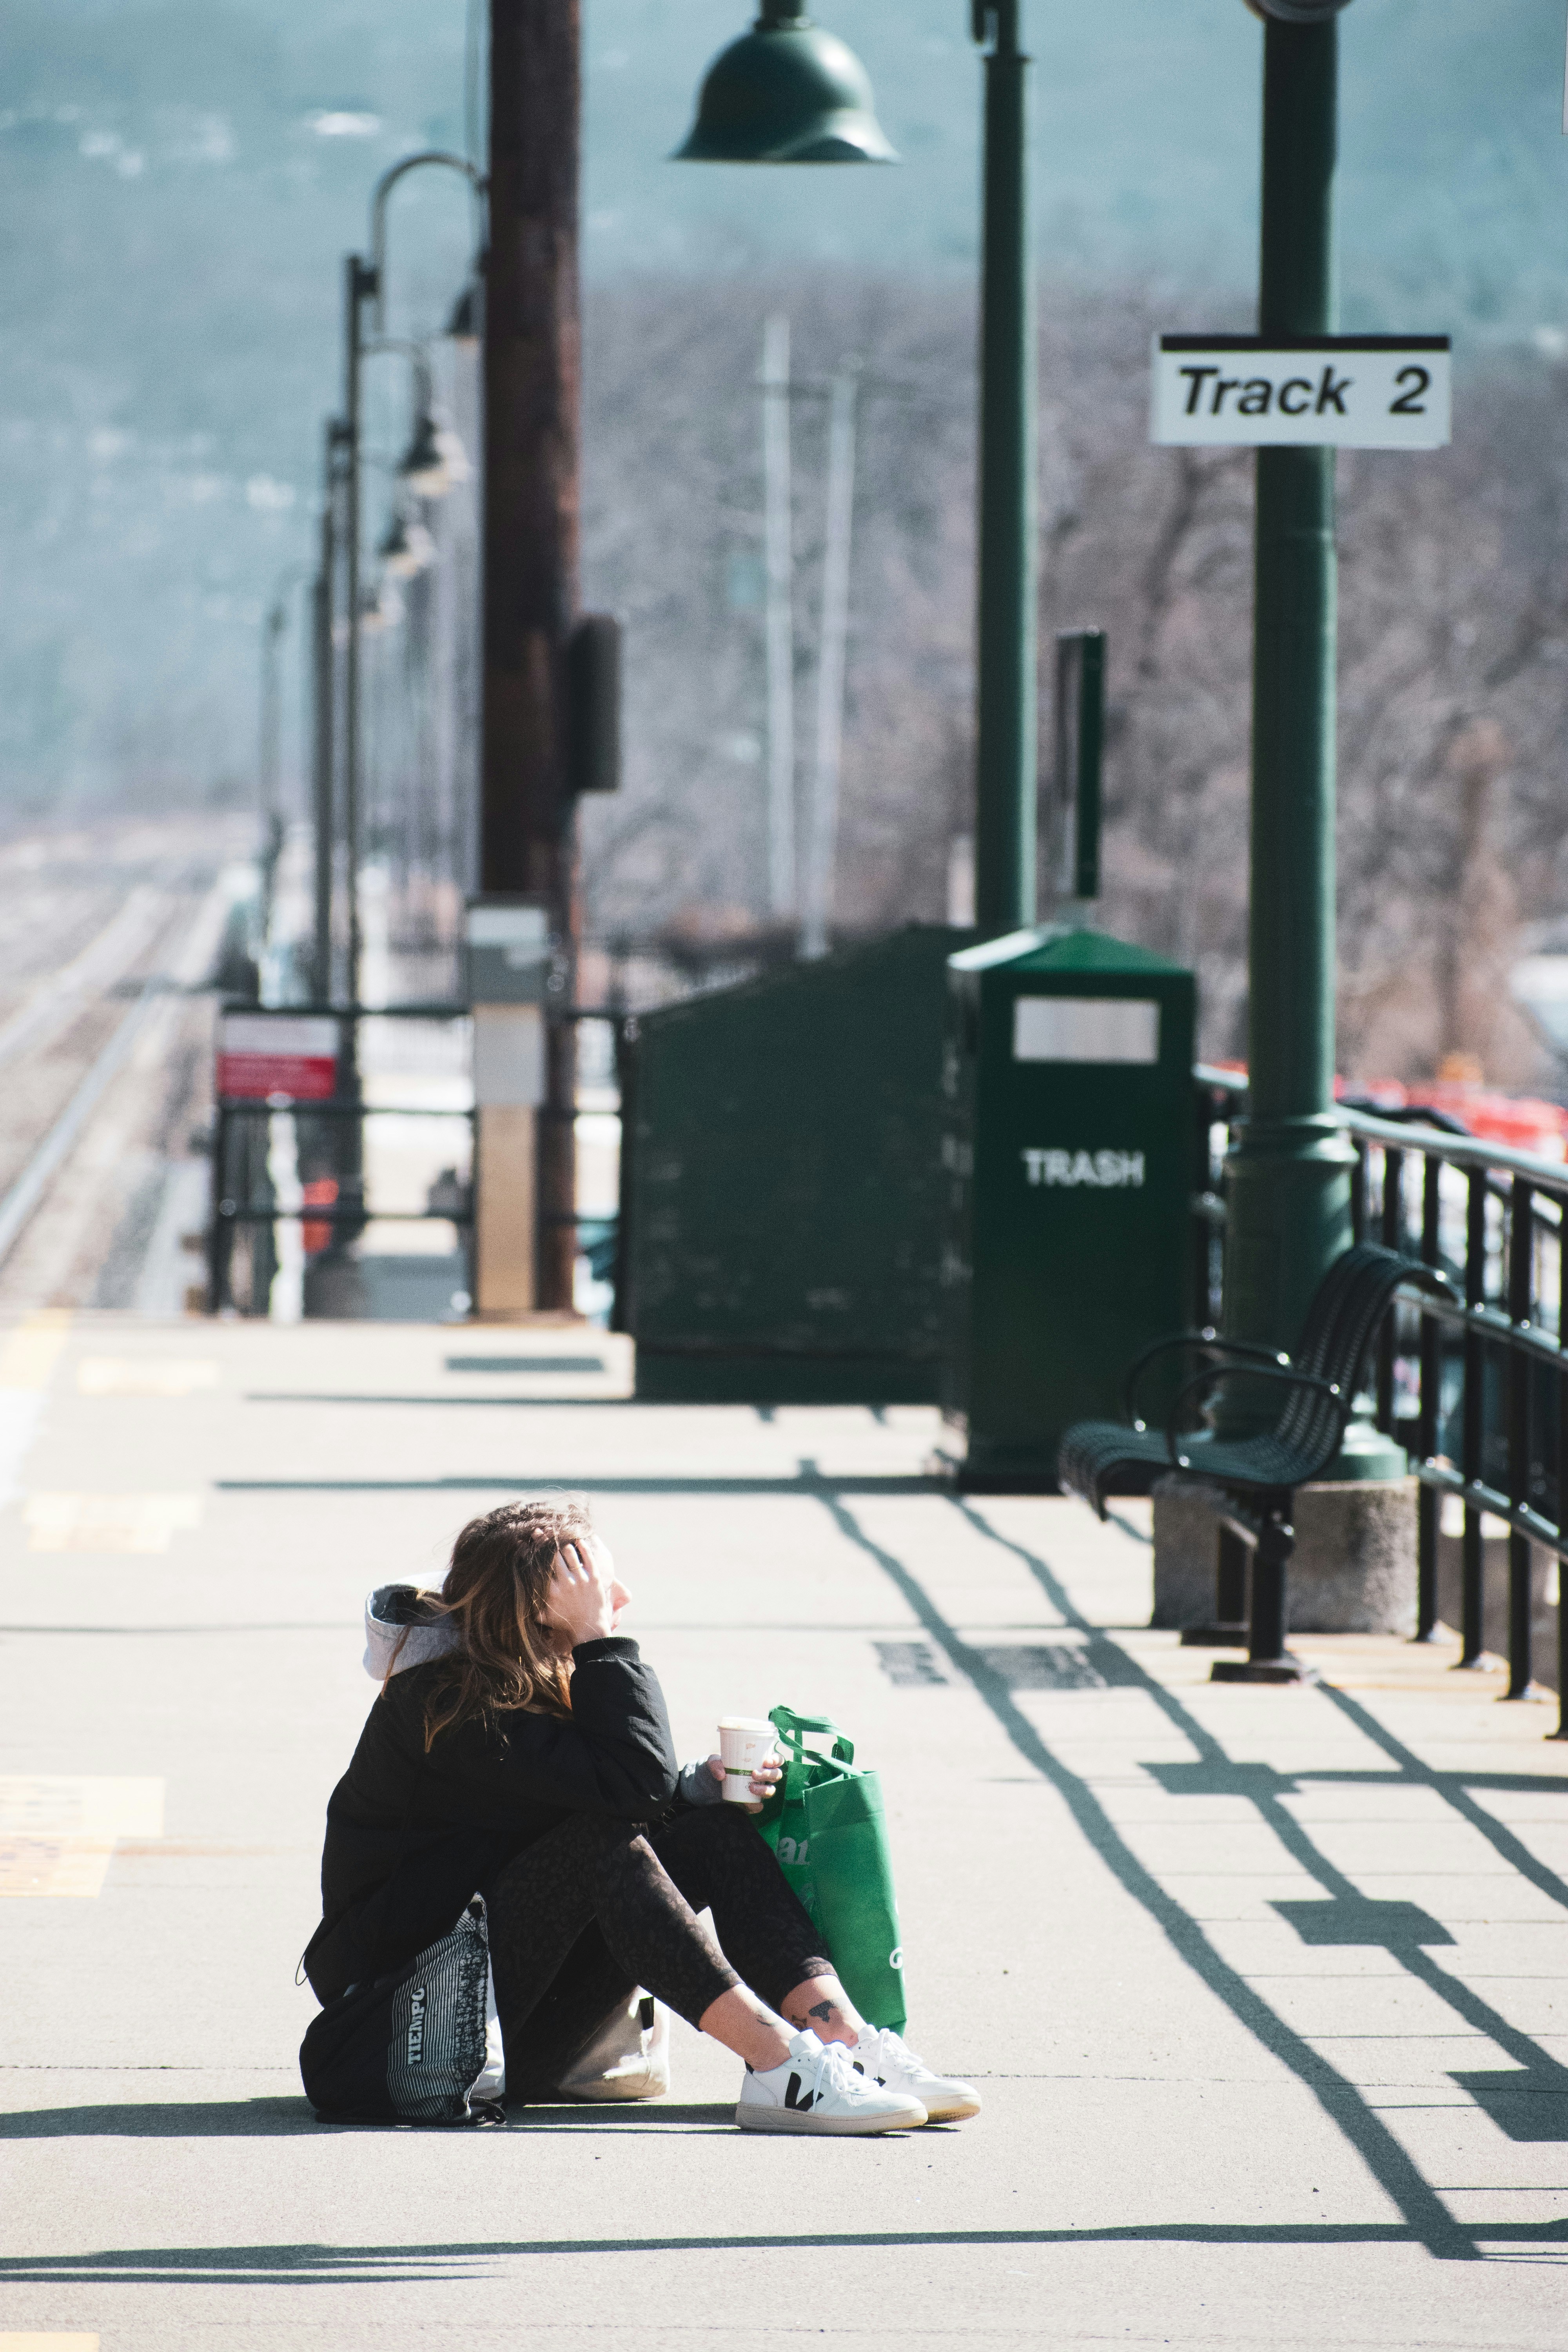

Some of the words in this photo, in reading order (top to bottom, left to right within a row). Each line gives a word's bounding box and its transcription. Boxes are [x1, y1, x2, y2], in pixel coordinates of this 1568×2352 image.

[1180, 365, 1353, 415] Track
[1389, 366, 1430, 414] 2
[1022, 1148, 1145, 1187] TRASH
[408, 1987, 425, 2065] TIEMPO
